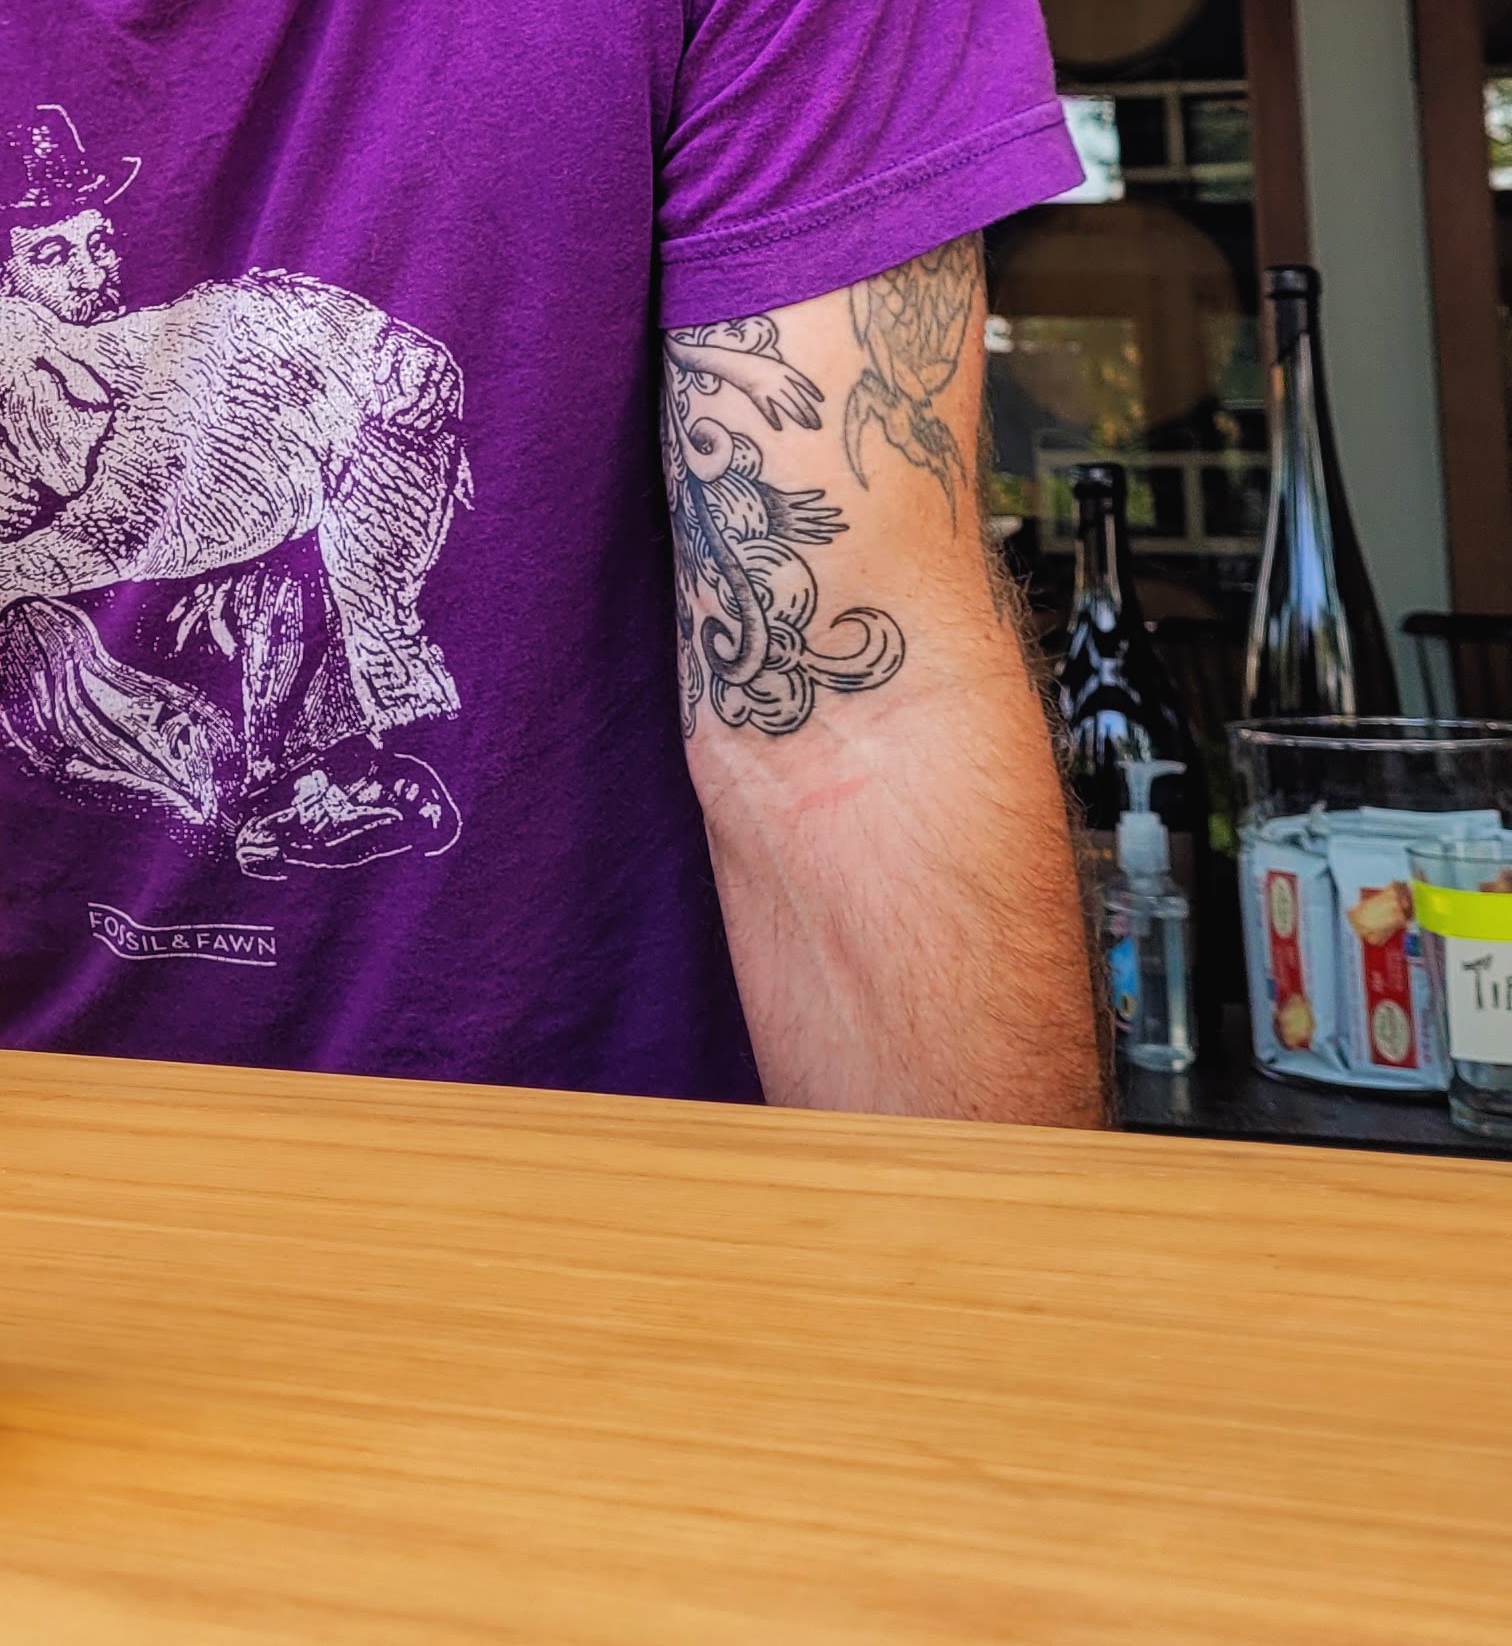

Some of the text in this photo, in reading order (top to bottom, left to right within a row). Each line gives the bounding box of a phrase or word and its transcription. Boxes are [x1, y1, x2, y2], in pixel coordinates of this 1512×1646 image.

[88, 910, 278, 955] FOSSIL & FAWN
